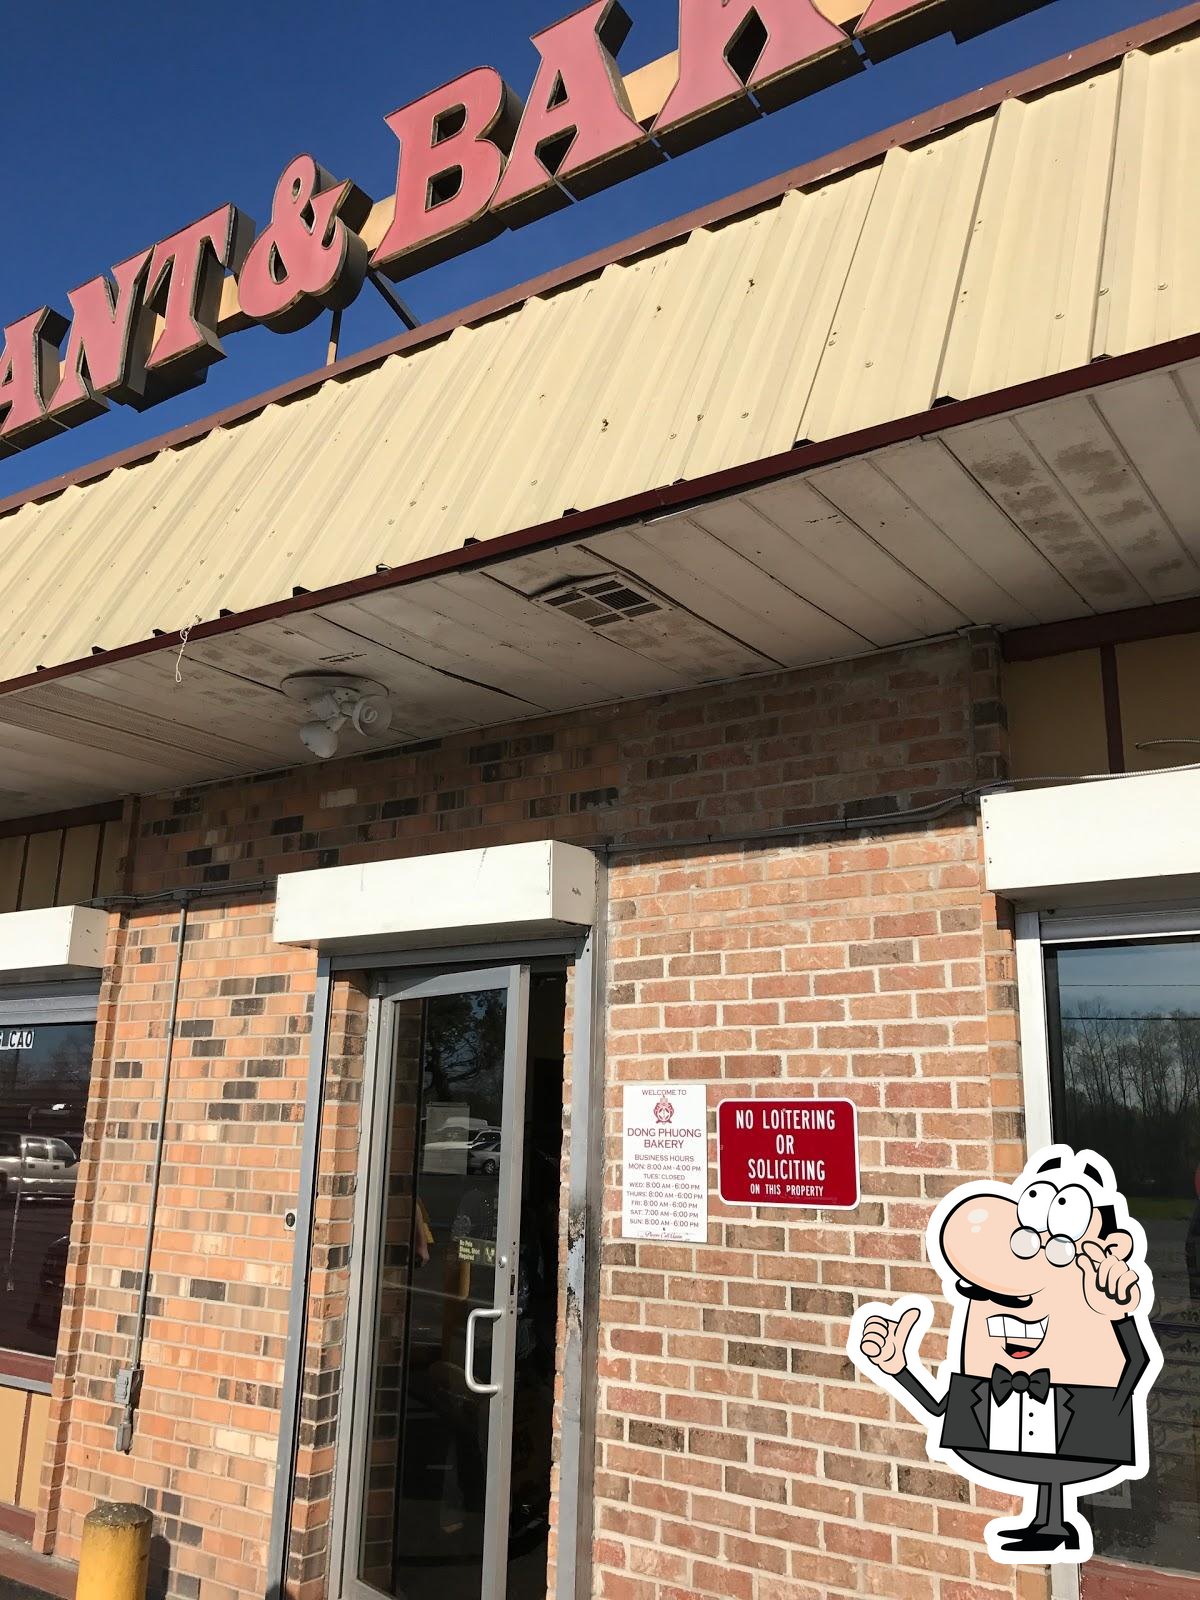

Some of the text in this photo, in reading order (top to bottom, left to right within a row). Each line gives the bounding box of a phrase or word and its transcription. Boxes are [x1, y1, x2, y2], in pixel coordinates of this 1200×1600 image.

[237, 152, 358, 318] &
[9, 1030, 33, 1047] CAO
[735, 1109, 836, 1130] NO LOITERING
[627, 1128, 702, 1138] DONG PHUONG
[644, 1139, 684, 1149] BAKERY
[776, 1134, 794, 1155] OR
[747, 1158, 826, 1181] SOLICITING
[750, 1183, 824, 1197] ON THIS PROPERTY
